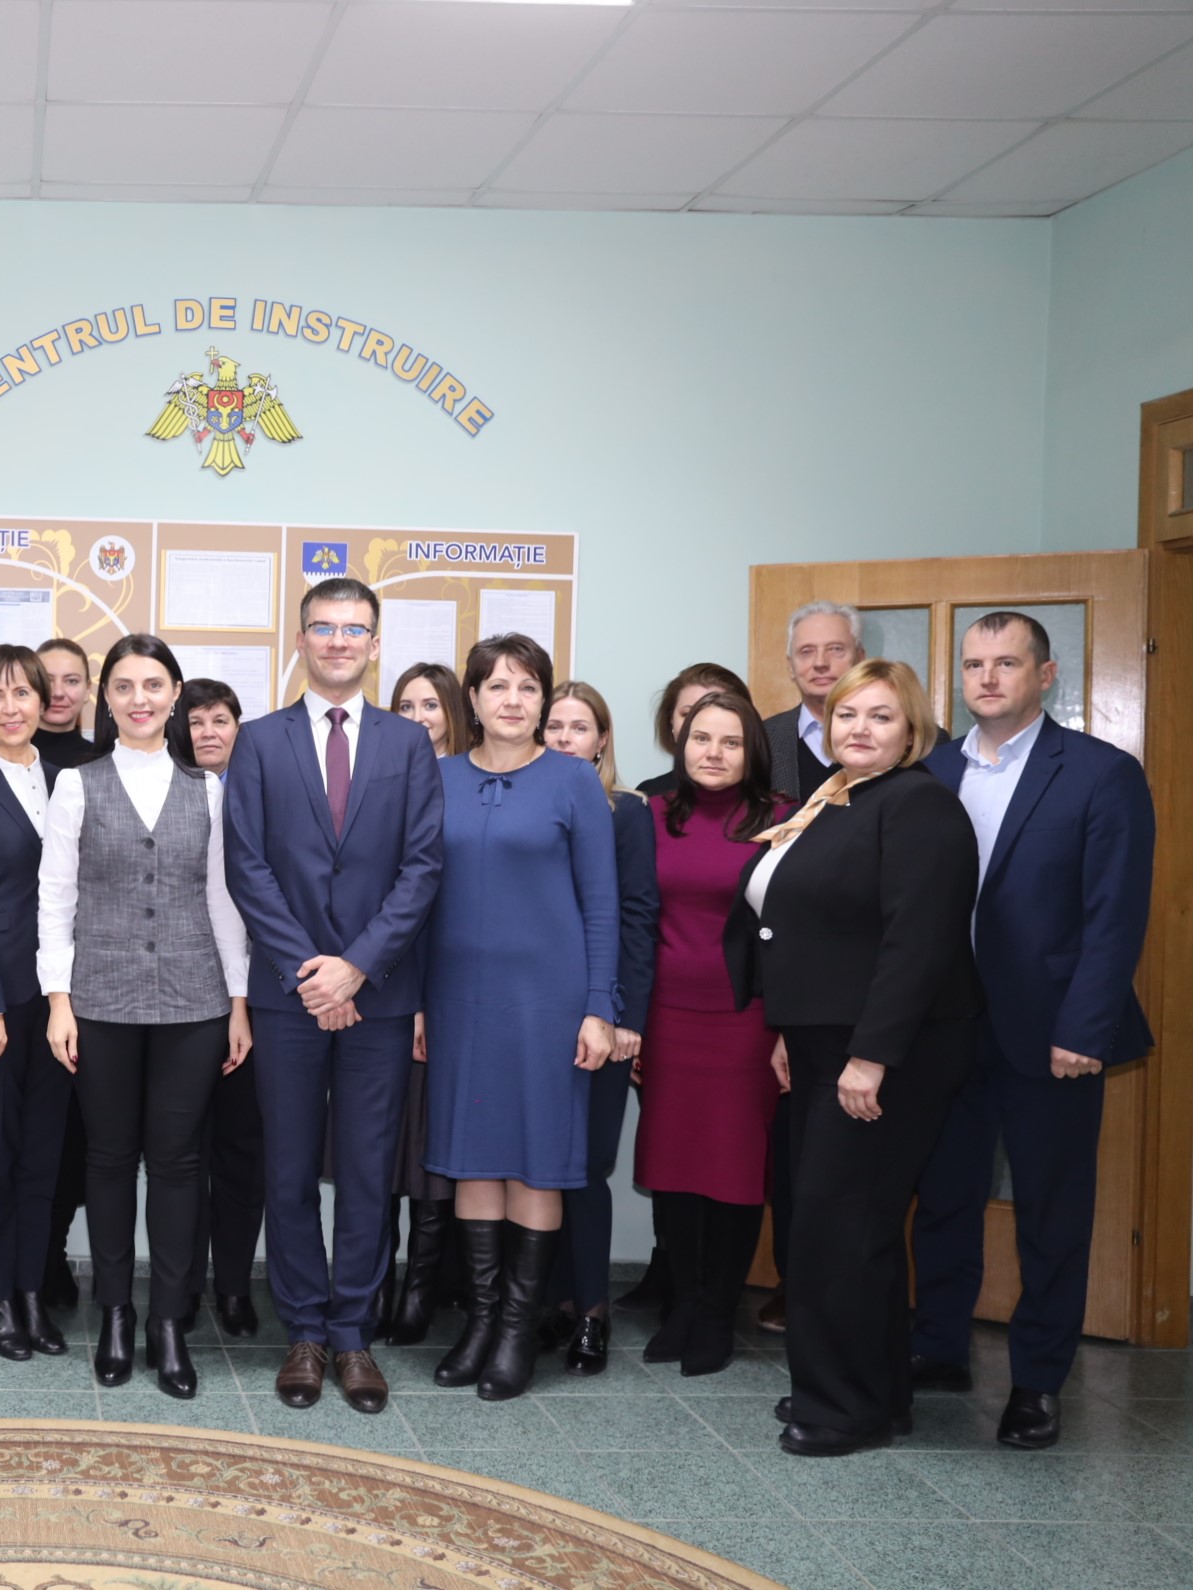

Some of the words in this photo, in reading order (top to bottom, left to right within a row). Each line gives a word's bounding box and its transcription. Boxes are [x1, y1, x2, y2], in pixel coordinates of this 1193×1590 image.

[174, 297, 238, 333] DE
[251, 298, 495, 439] INSTRUIRE
[408, 542, 546, 568] INFORMAȚIE
